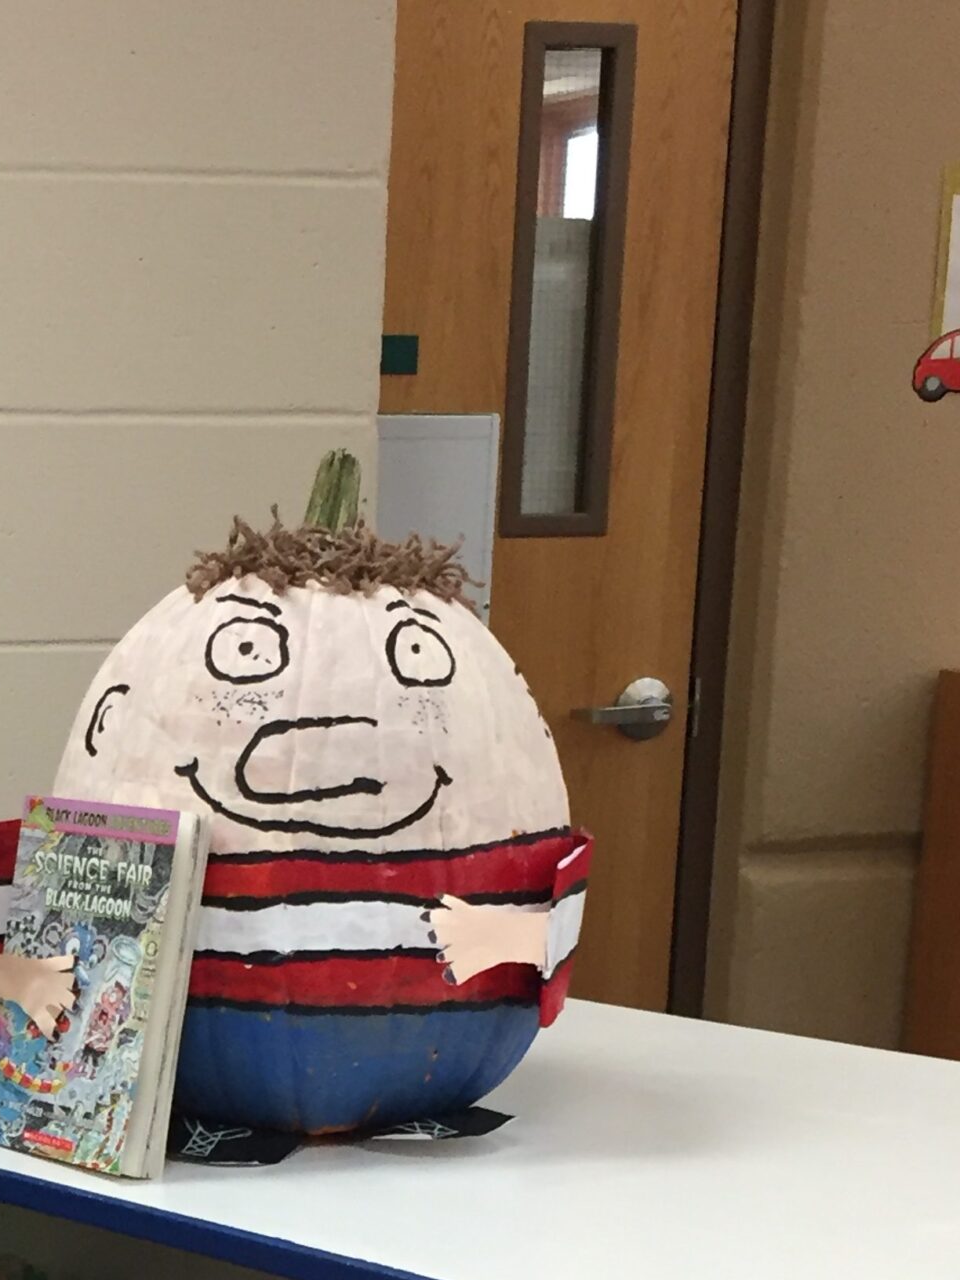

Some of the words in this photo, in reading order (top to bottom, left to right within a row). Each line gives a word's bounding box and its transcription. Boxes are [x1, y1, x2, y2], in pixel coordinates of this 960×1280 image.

[73, 810, 109, 828] LAGOON
[33, 851, 110, 880] SCIENCE
[116, 861, 153, 888] FAIR
[67, 880, 92, 891] FROM
[95, 884, 112, 894] THE
[45, 887, 81, 911] BLACK
[84, 894, 132, 917] LAGOON
